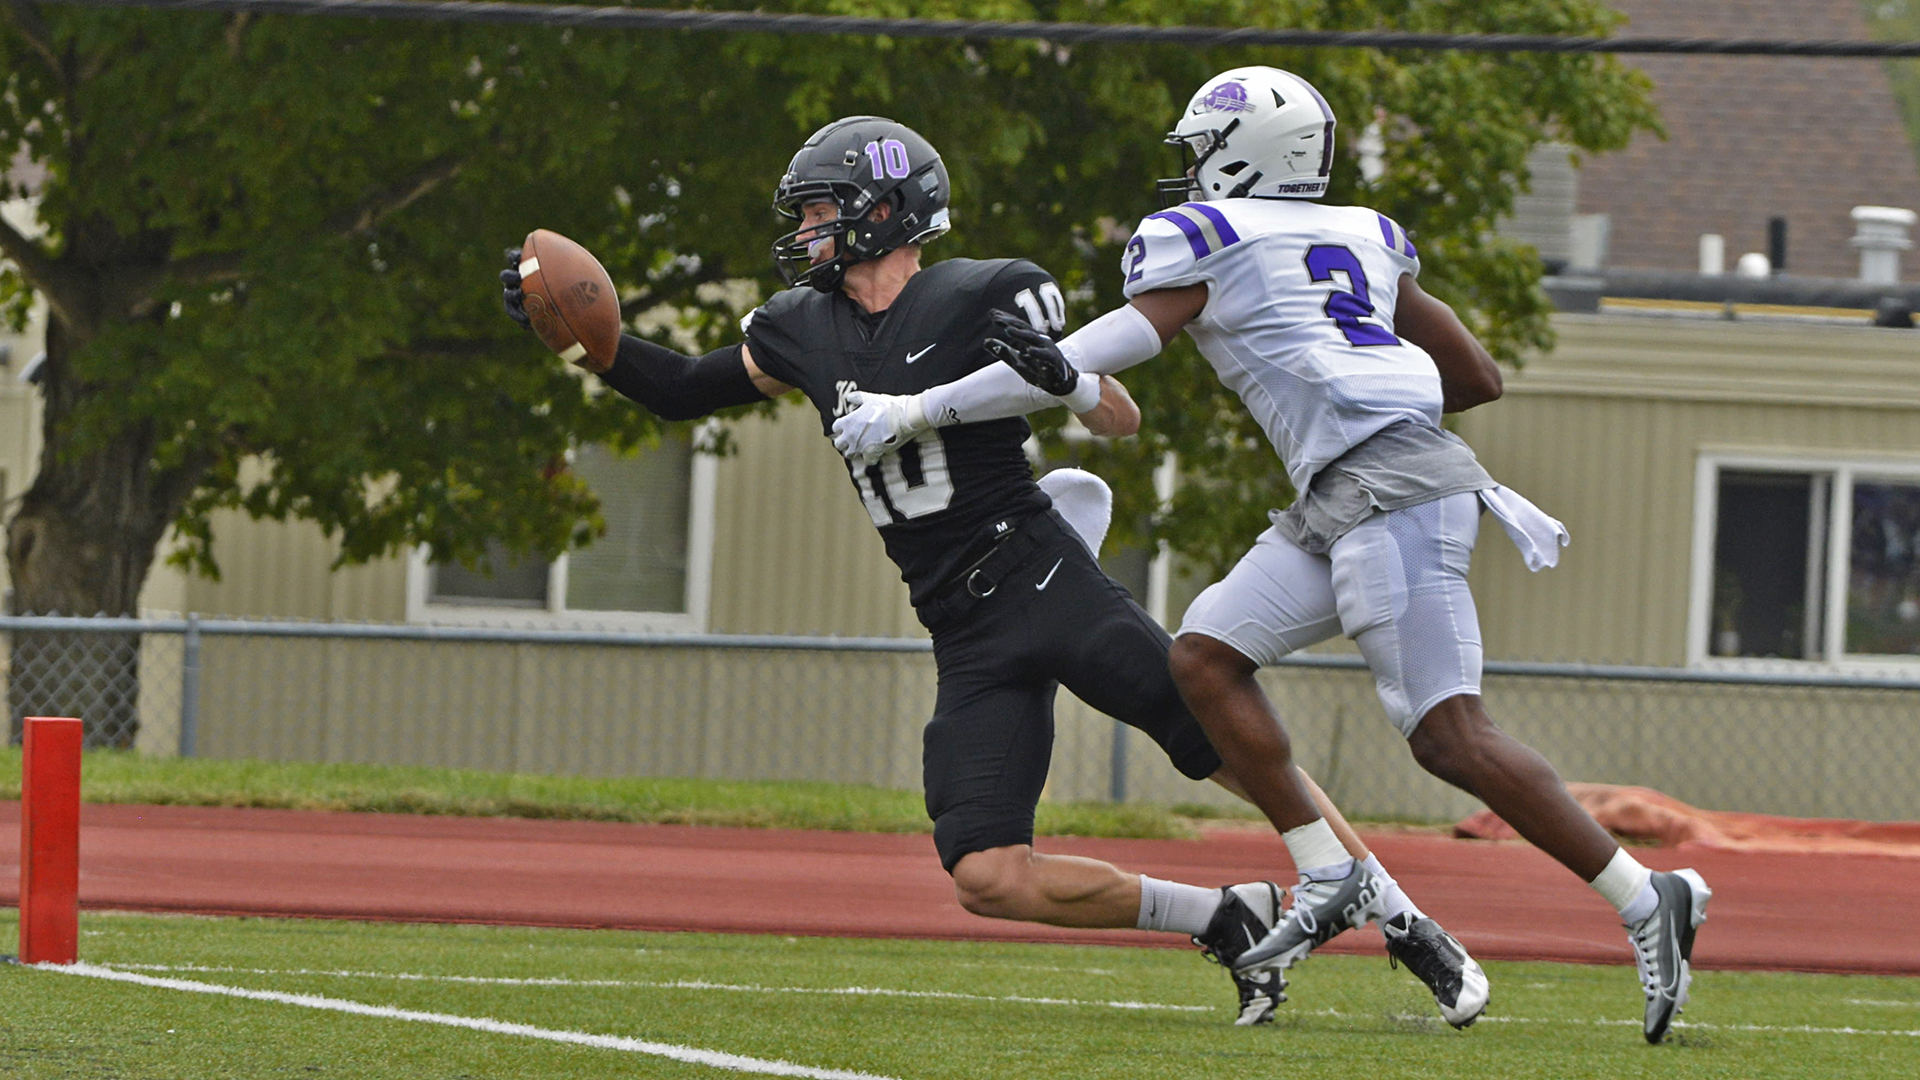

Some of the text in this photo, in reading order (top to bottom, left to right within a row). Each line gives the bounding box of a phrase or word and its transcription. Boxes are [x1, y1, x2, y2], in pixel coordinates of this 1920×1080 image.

[864, 138, 911, 181] 10
[1278, 183, 1321, 194] TOGETHER
[1126, 234, 1147, 285] 2
[1014, 281, 1066, 334] 10
[1301, 242, 1403, 348] 2
[851, 427, 955, 528] 10
